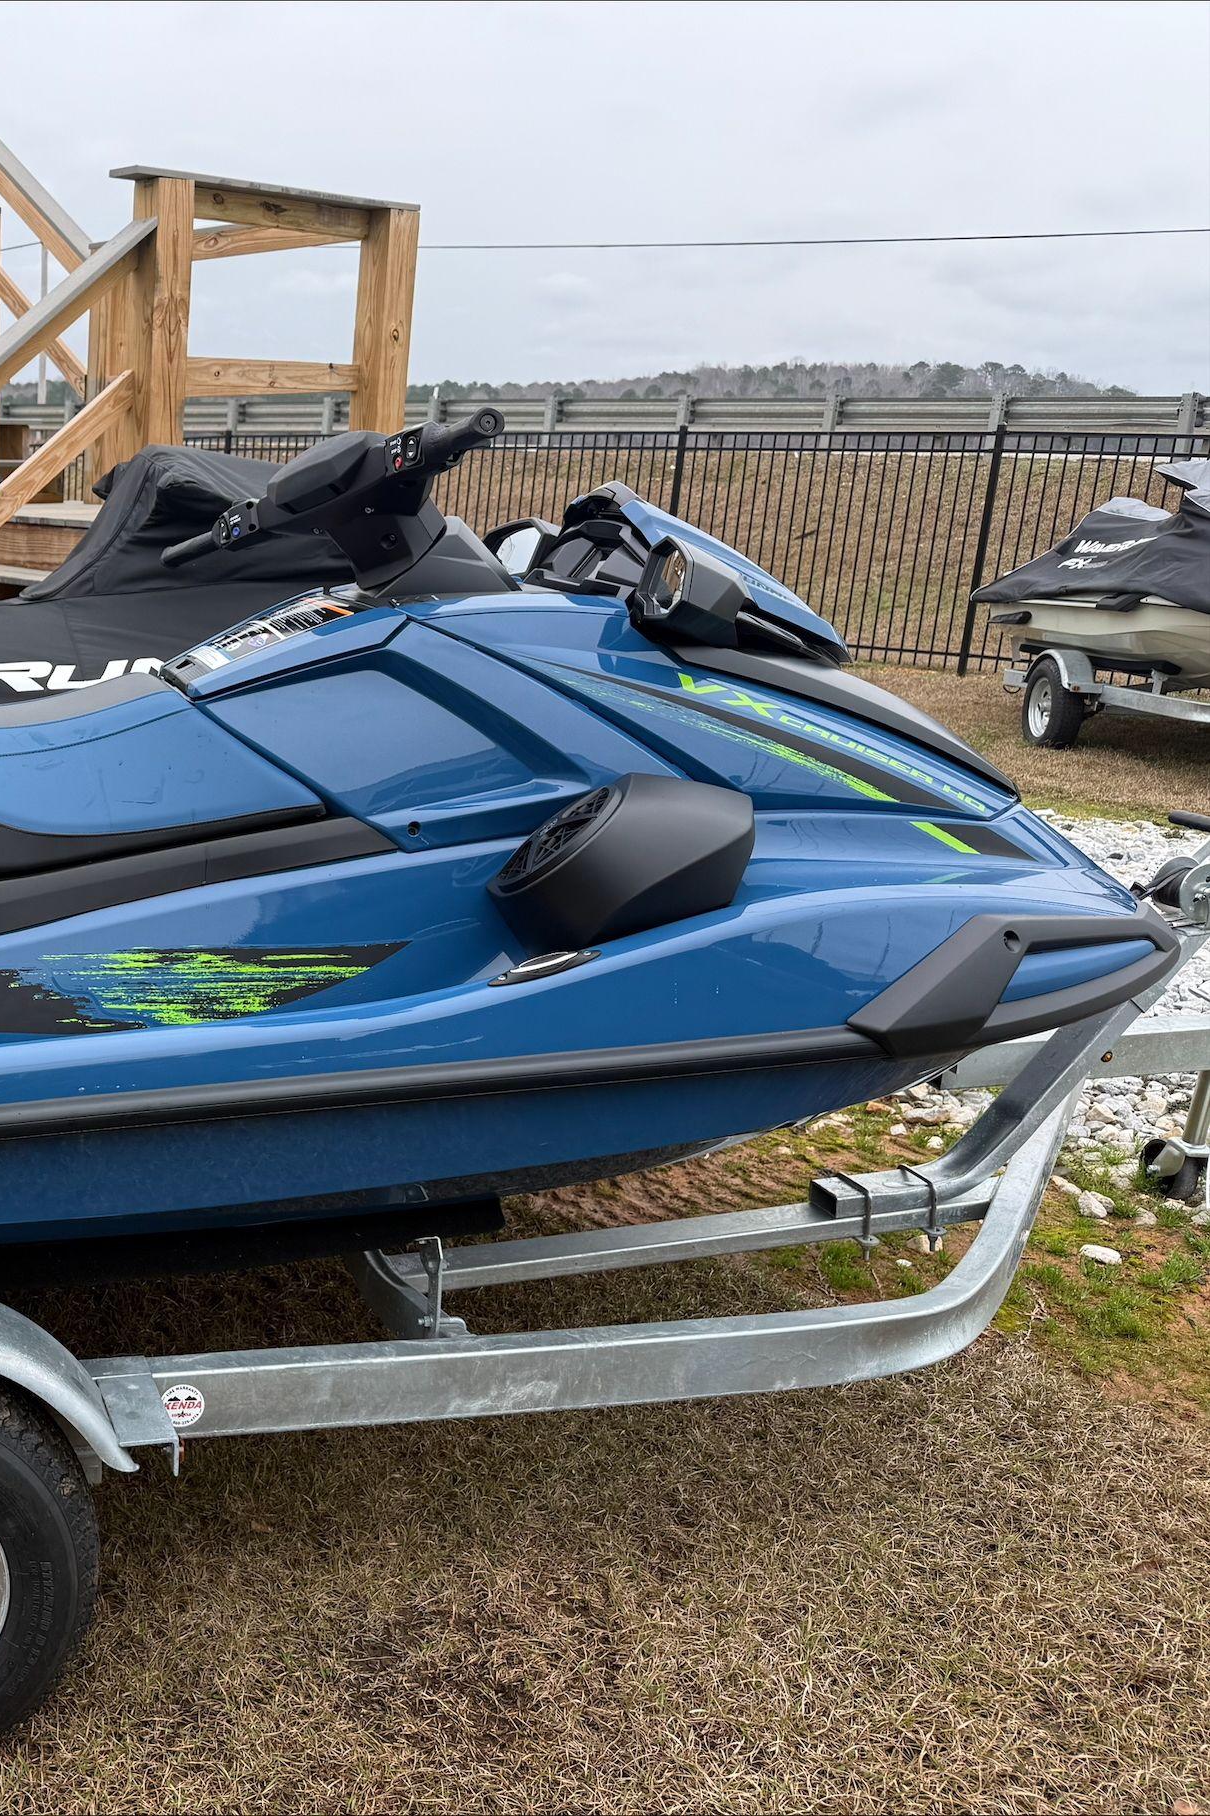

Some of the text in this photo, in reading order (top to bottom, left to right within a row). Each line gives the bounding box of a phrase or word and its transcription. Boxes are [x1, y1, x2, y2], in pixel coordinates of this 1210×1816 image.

[677, 672, 987, 813] VX CRUISER HO
[164, 1400, 202, 1410] KENDA
